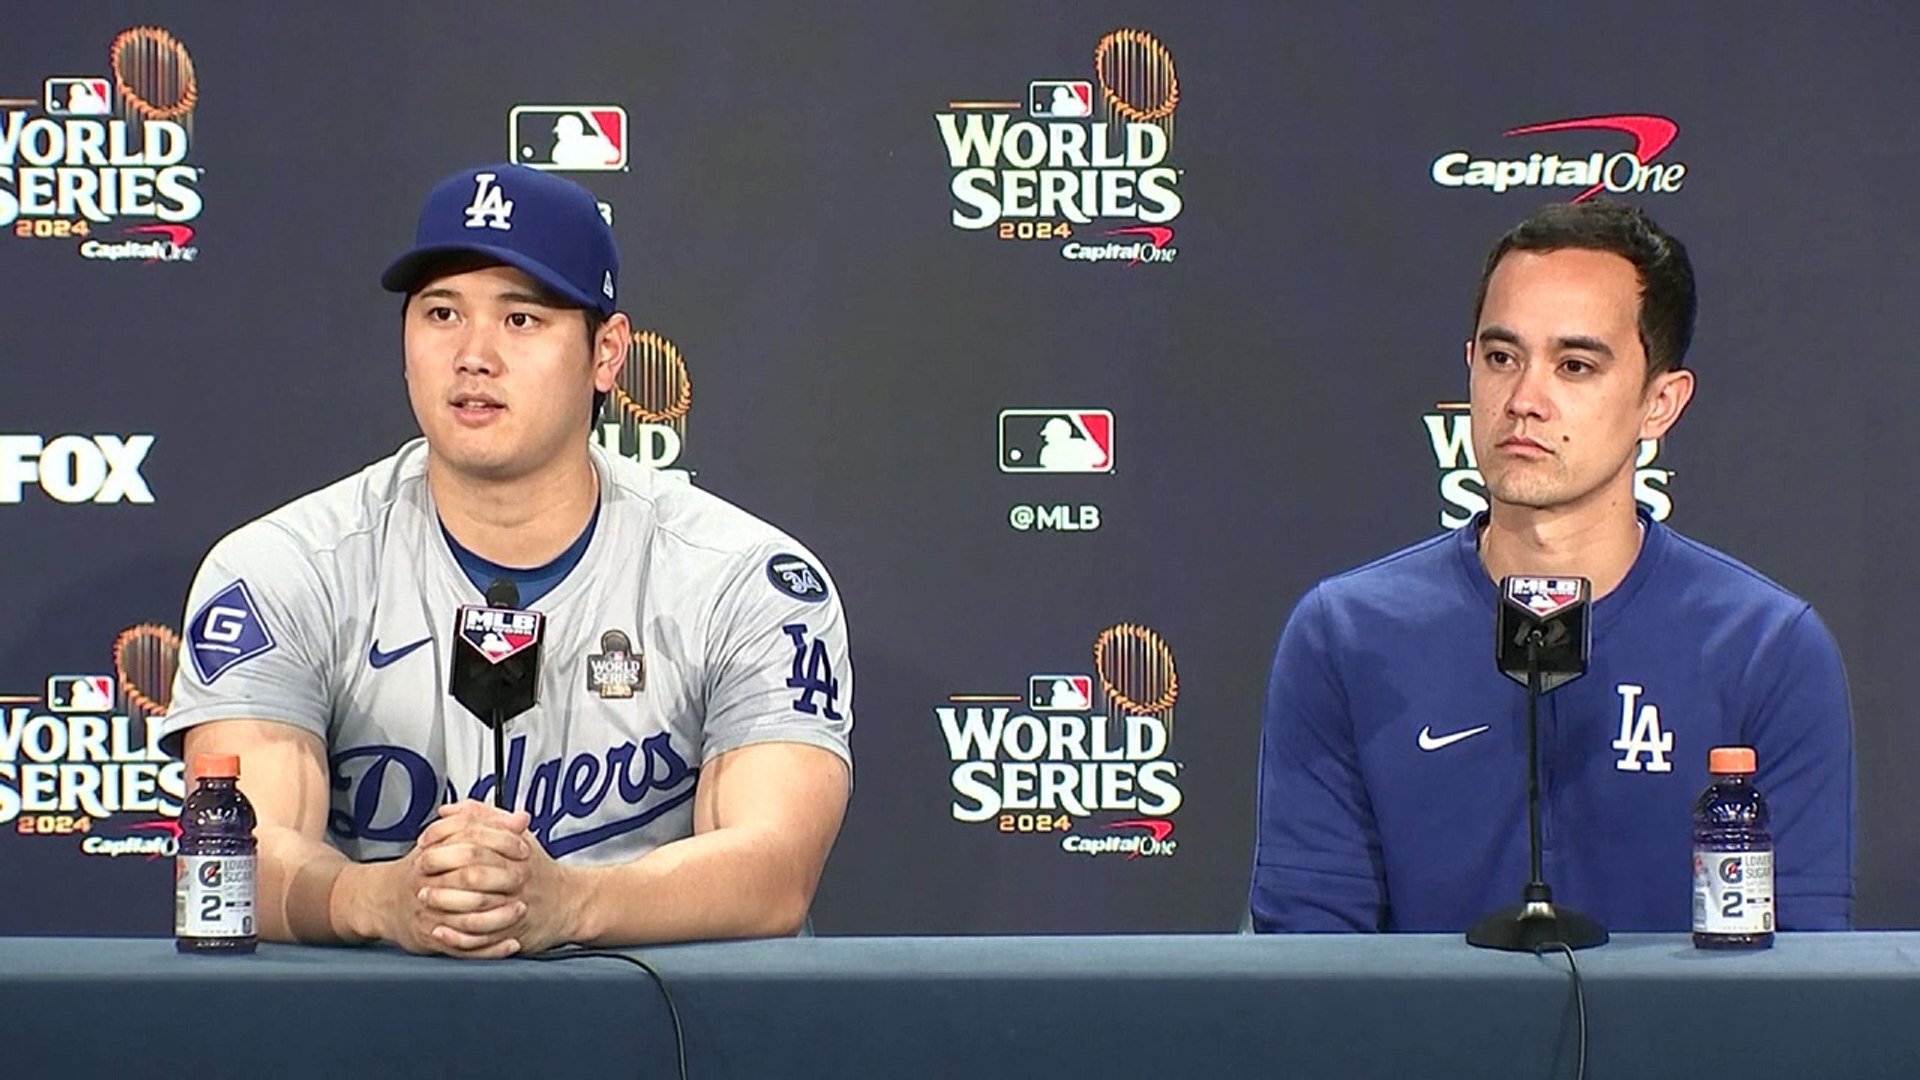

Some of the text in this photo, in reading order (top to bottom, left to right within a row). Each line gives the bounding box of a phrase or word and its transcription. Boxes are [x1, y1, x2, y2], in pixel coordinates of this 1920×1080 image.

[935, 113, 1168, 168] WORLD
[465, 173, 514, 230] LA
[951, 167, 1183, 230] SERIES
[15, 219, 90, 238] 2024
[999, 222, 1073, 240] 2024
[0, 434, 156, 503] FOX
[1009, 505, 1101, 531] @MLB
[781, 569, 824, 594] 34
[466, 610, 536, 630] MLB
[782, 624, 844, 721] LA
[935, 708, 1168, 762] WORLD
[1612, 684, 1674, 771] LA
[951, 761, 1183, 822] SERIES
[17, 815, 92, 834] 2024
[999, 814, 1073, 832] 2024
[200, 895, 222, 921] 2
[1722, 892, 1744, 918] 2
